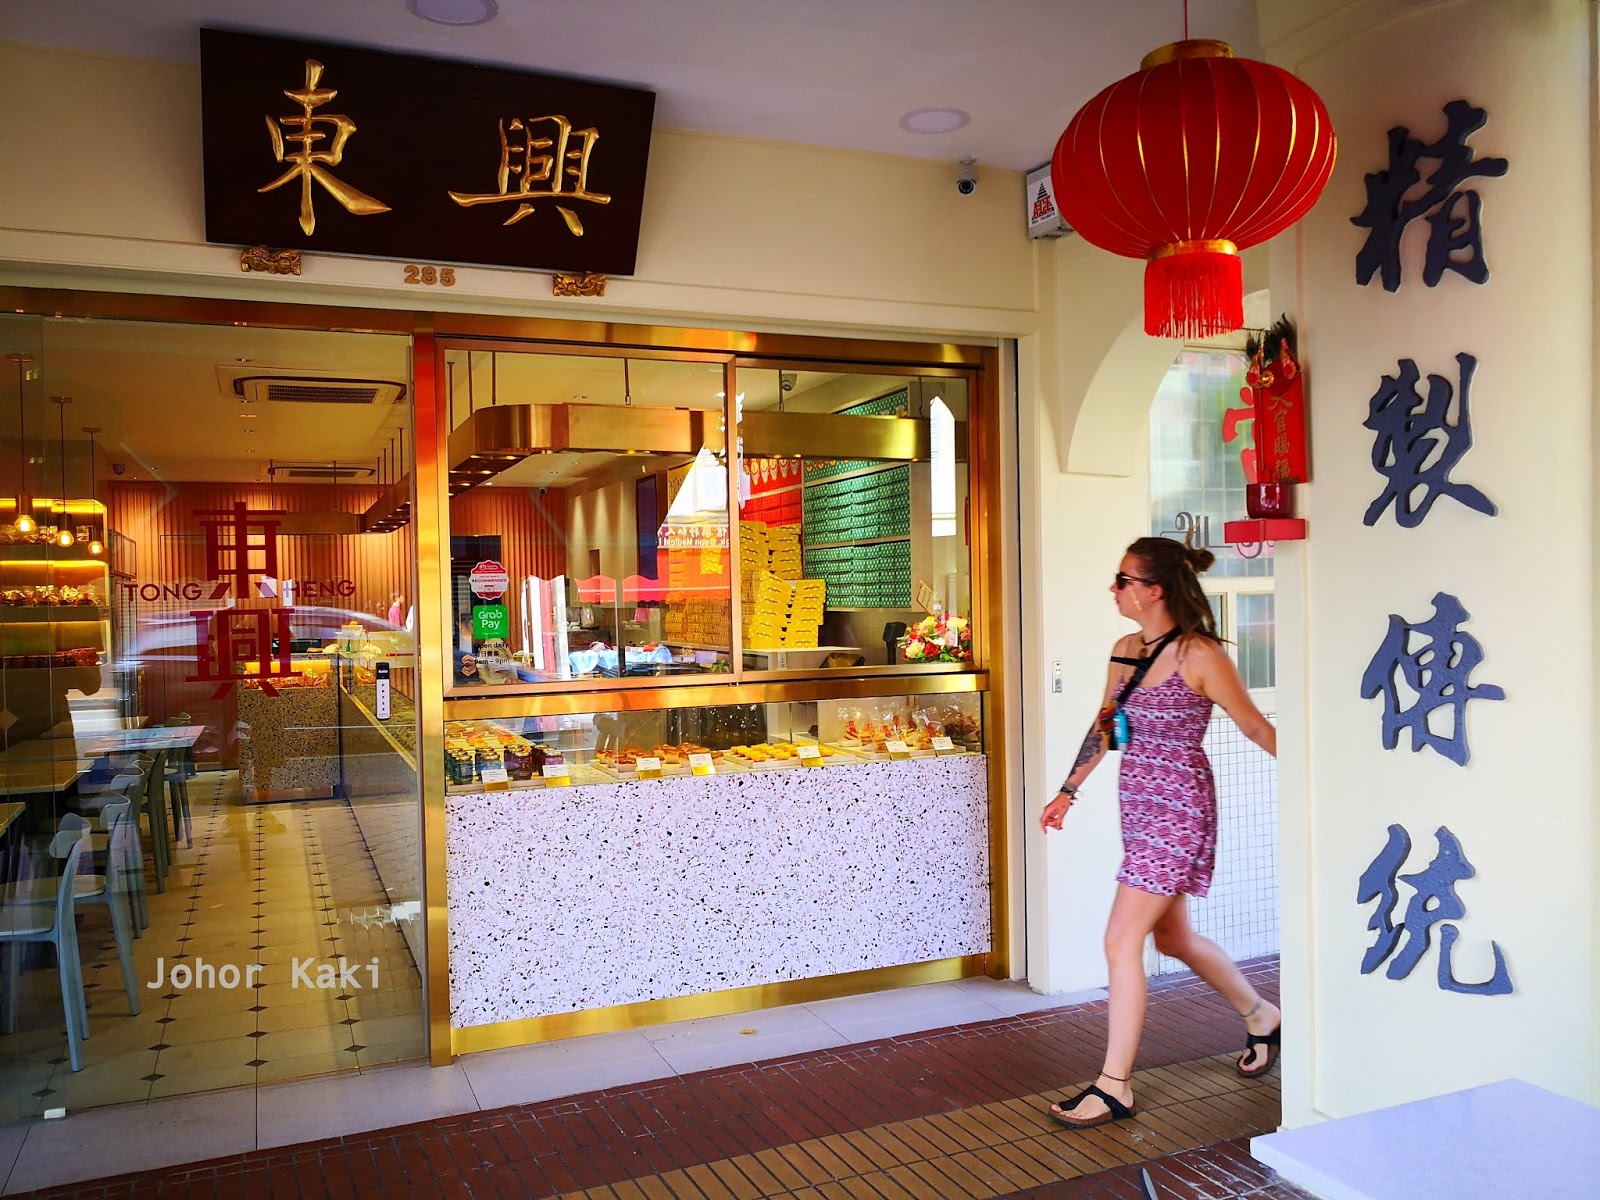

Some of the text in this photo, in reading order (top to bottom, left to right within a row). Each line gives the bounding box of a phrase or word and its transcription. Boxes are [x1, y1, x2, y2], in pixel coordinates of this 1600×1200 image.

[257, 59, 611, 236] 東興
[403, 264, 455, 287] 285
[1350, 100, 1513, 995] 精製傳統
[124, 580, 356, 602] TONG HENG
[478, 609, 503, 620] Grab
[481, 619, 500, 630] Pay
